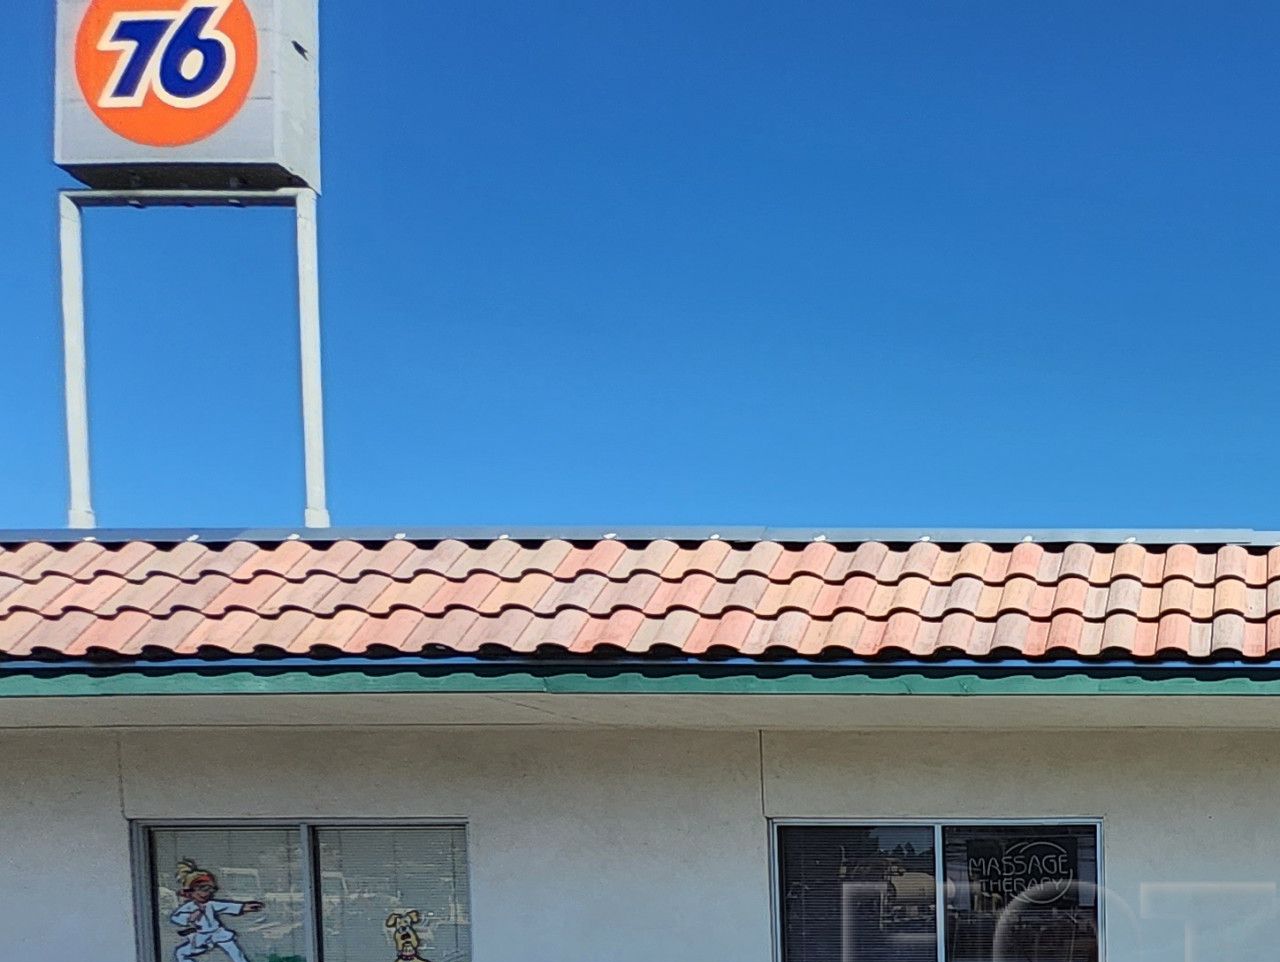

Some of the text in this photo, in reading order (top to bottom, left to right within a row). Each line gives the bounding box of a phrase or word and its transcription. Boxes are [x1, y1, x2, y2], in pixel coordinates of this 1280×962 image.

[97, 0, 236, 109] 76
[968, 854, 1068, 877] MASSAGE
[979, 876, 1064, 893] THERAPY
